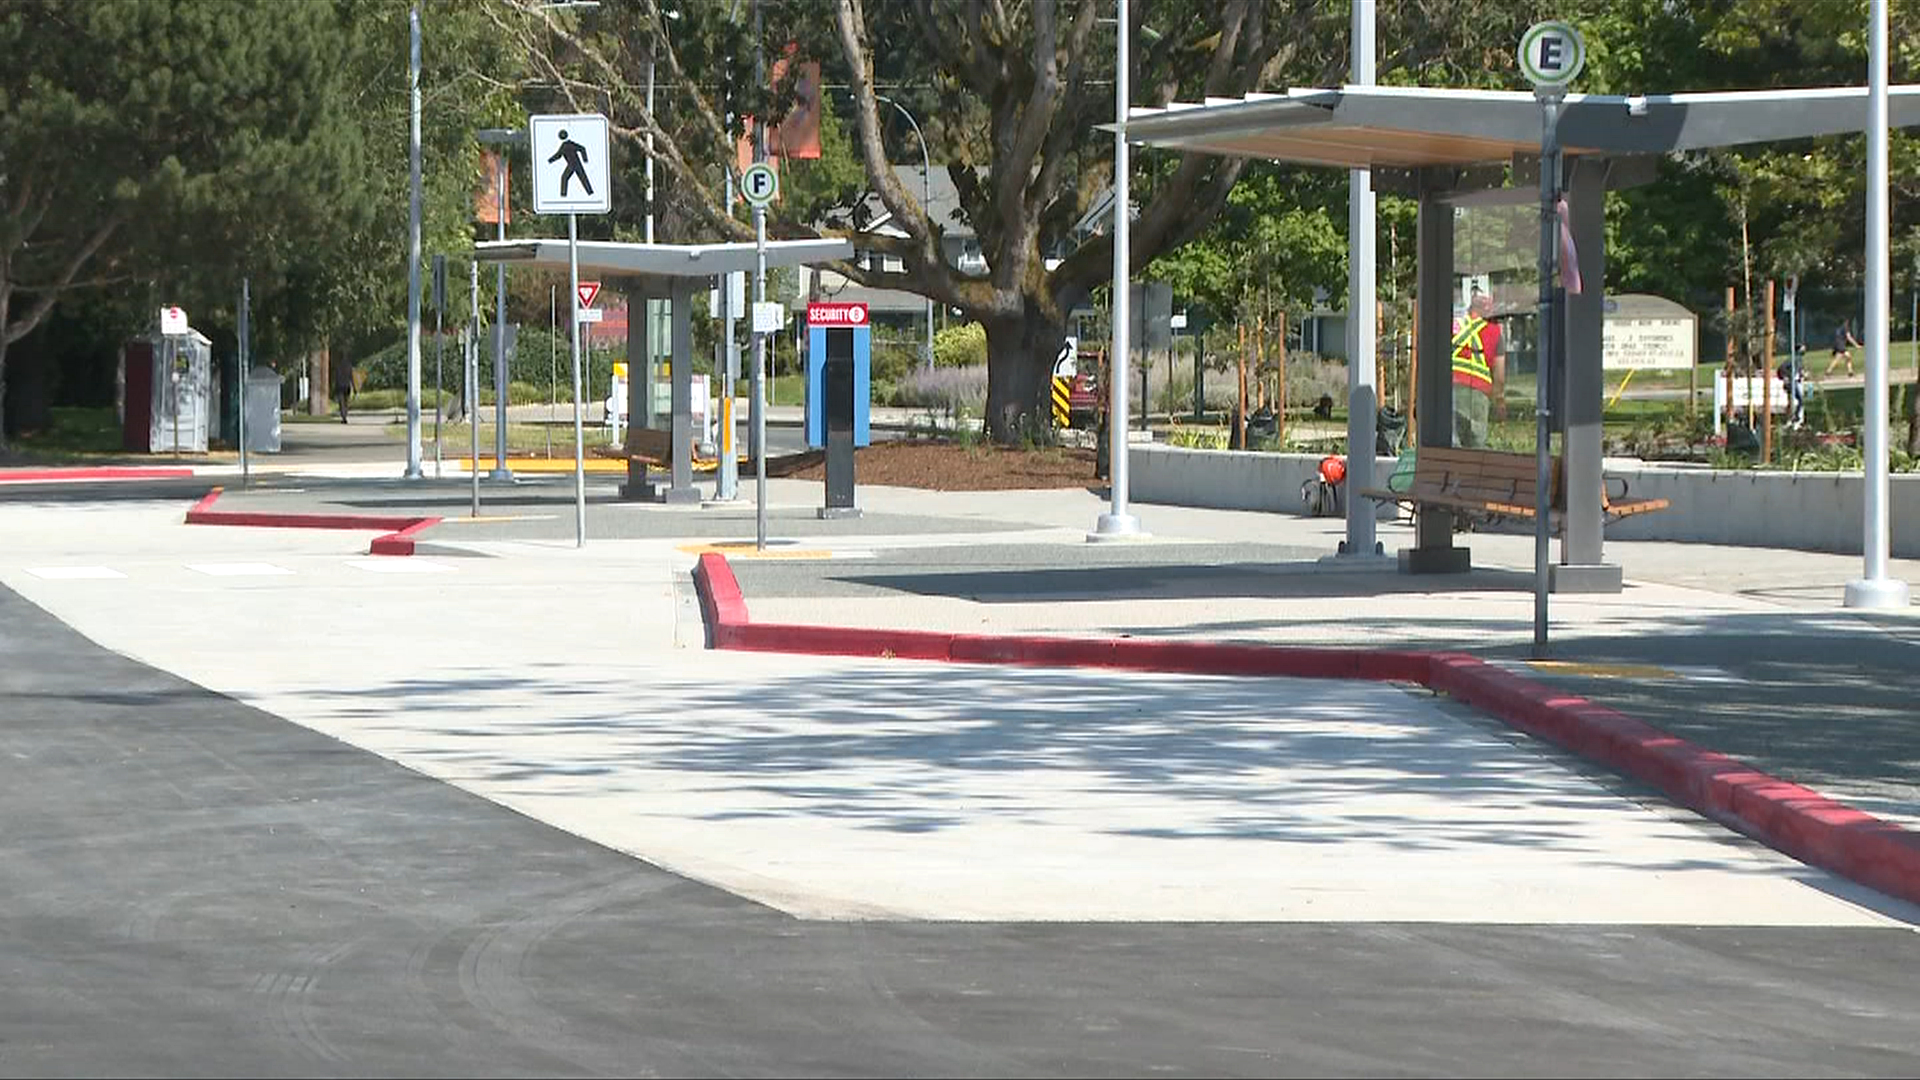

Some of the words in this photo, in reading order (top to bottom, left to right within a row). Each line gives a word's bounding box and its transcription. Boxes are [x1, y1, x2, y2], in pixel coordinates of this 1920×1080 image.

[1540, 37, 1562, 69] E
[753, 173, 766, 194] F
[809, 307, 849, 322] SECURITY
